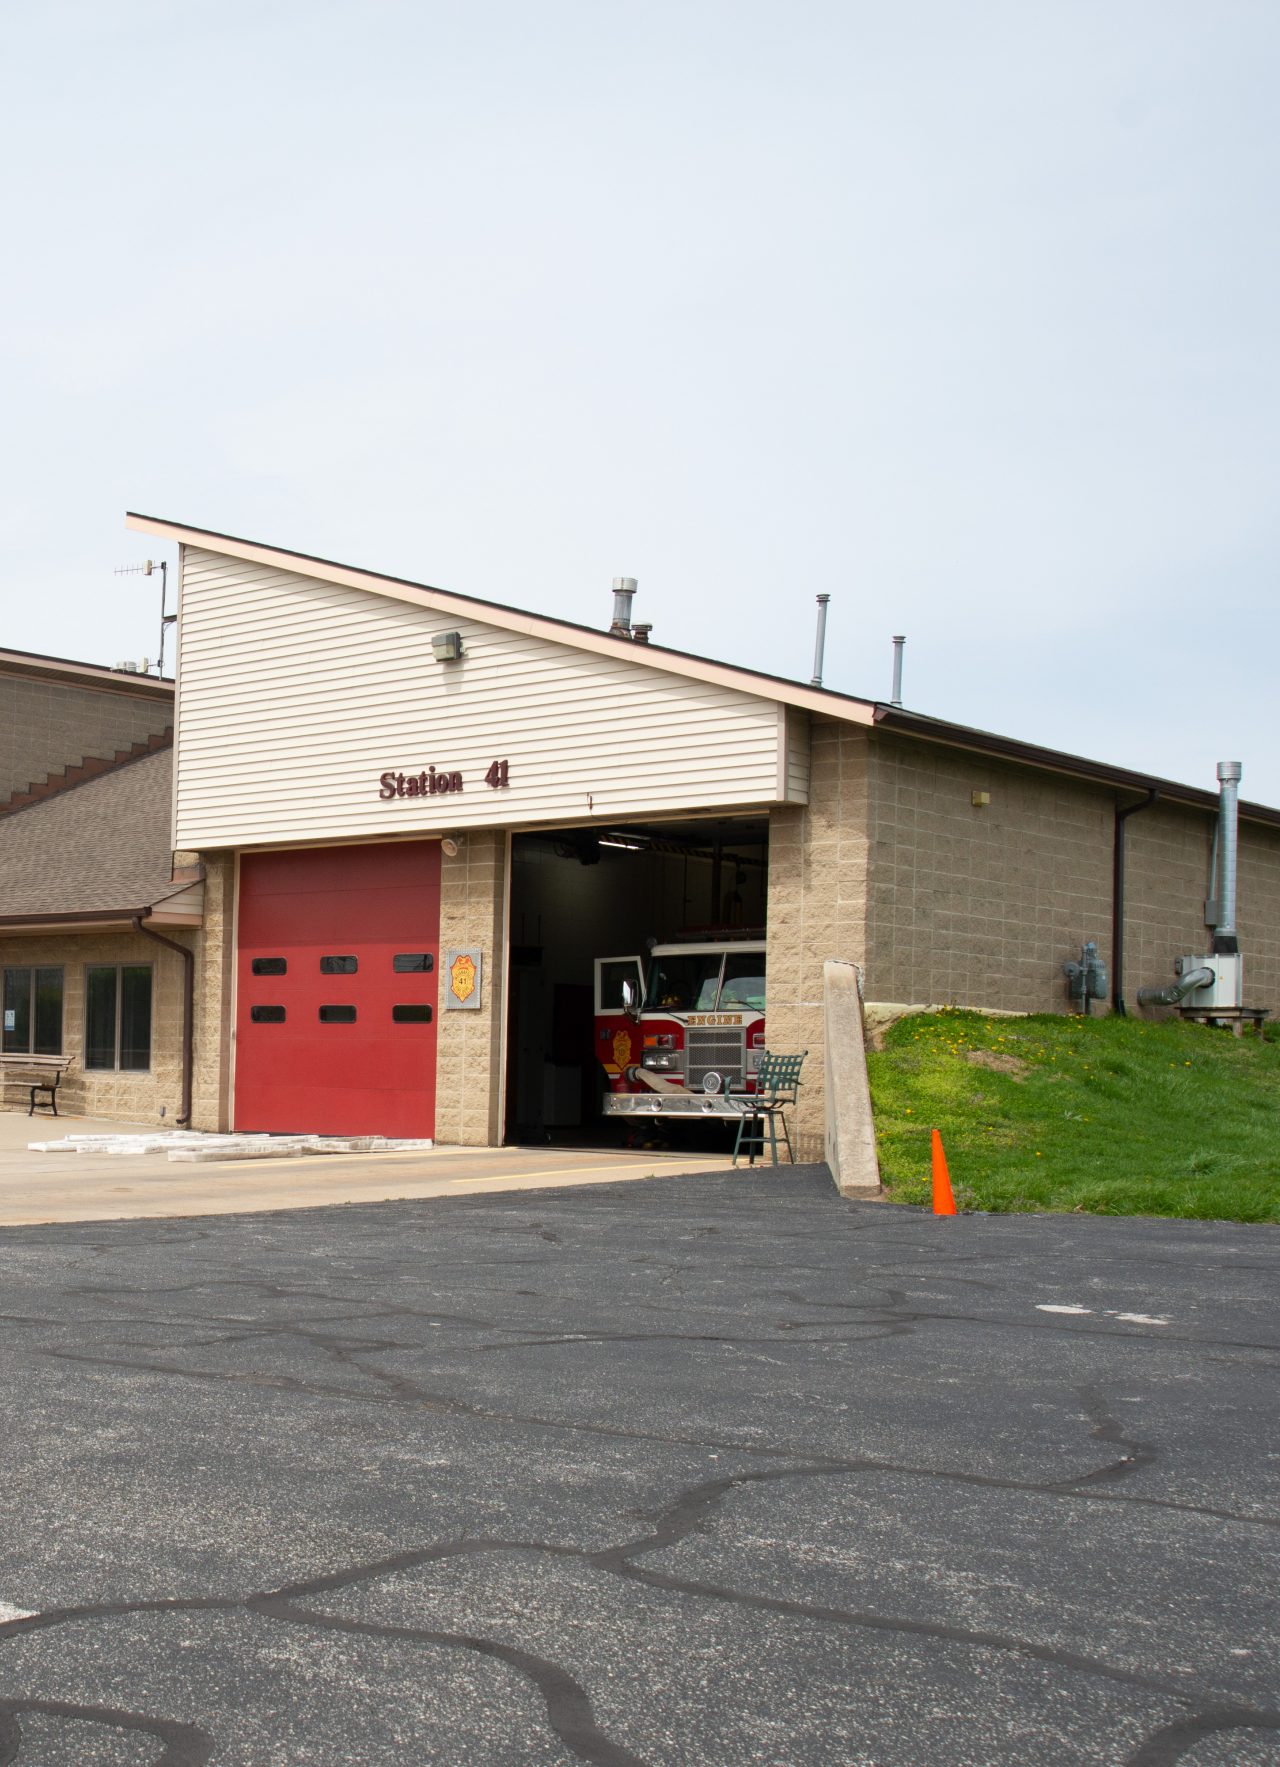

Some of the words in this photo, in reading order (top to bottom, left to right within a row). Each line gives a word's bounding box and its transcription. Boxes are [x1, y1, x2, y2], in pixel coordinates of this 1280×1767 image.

[379, 765, 464, 799] Station
[484, 759, 510, 788] 41
[458, 977, 468, 985] 41
[687, 1014, 743, 1026] ENGINE
